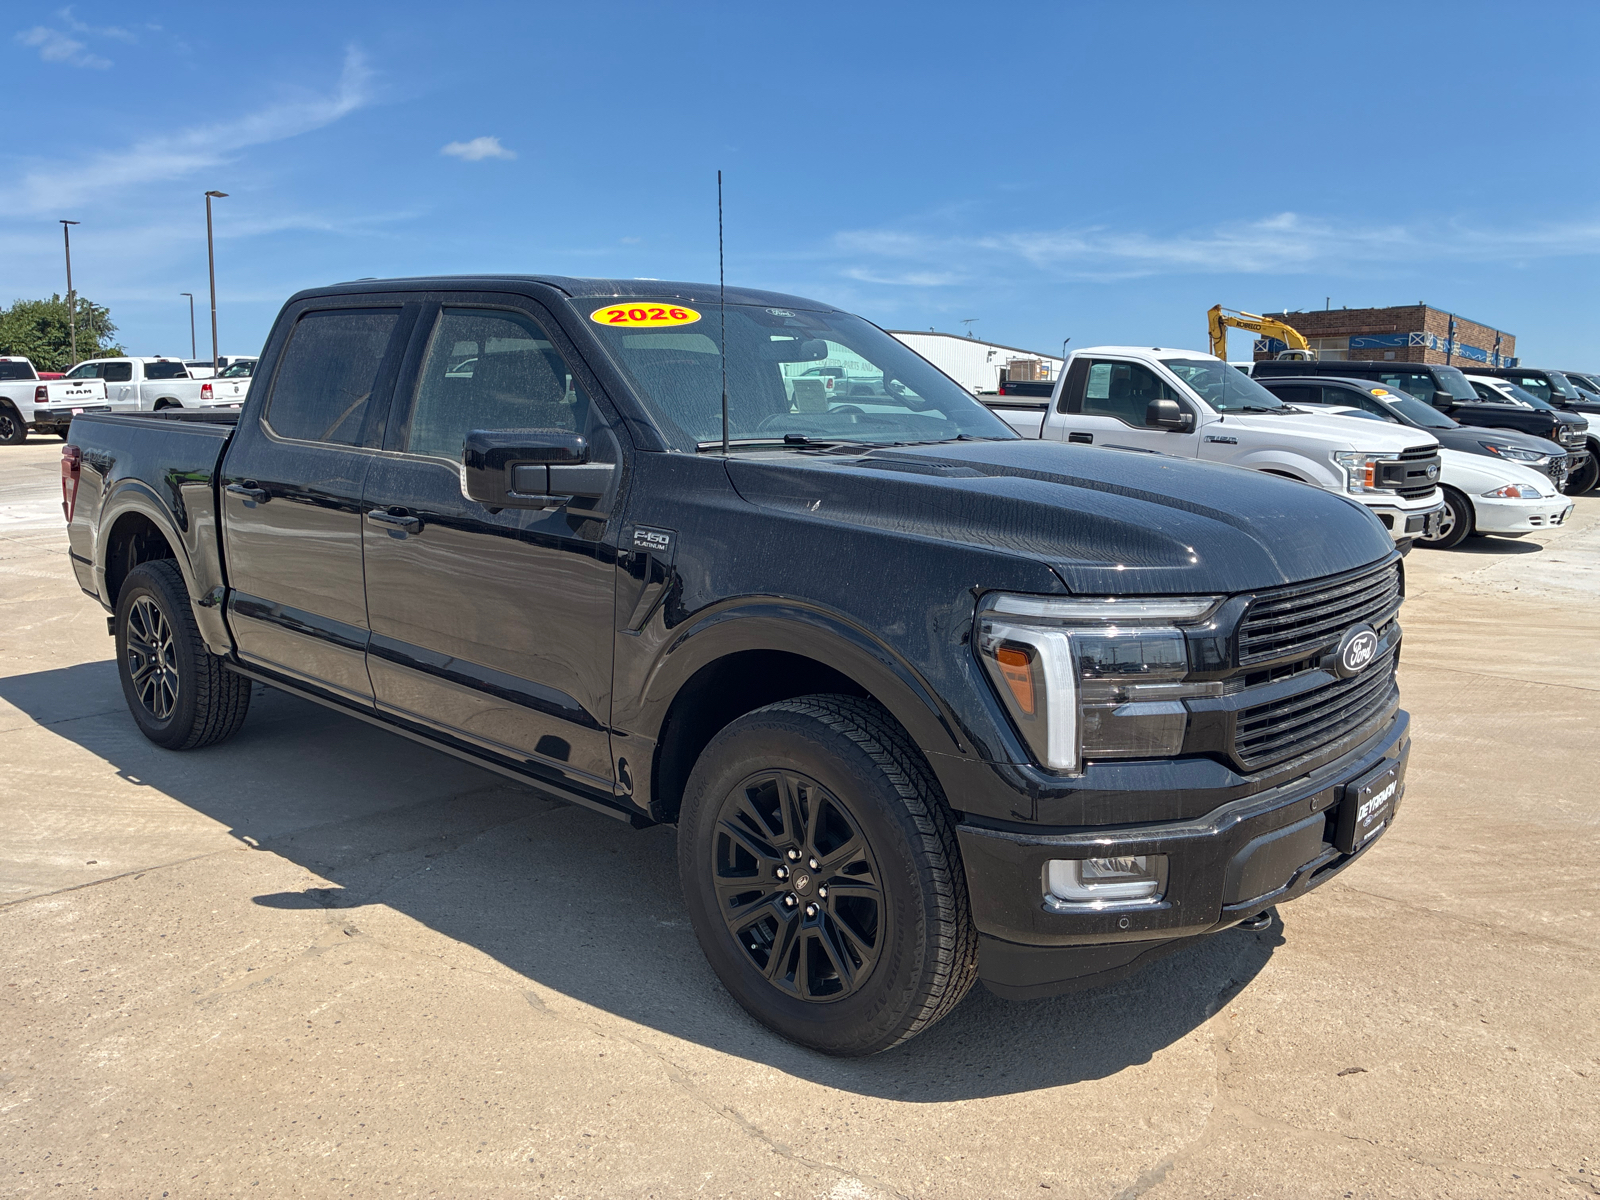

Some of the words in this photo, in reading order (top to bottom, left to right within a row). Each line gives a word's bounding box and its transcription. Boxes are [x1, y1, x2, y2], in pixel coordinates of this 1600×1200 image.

[607, 308, 688, 323] 2026
[634, 530, 669, 544] F-150
[634, 540, 665, 550] PLATINUM
[1350, 637, 1372, 666] Ford
[1357, 780, 1397, 822] DEYARMAN
